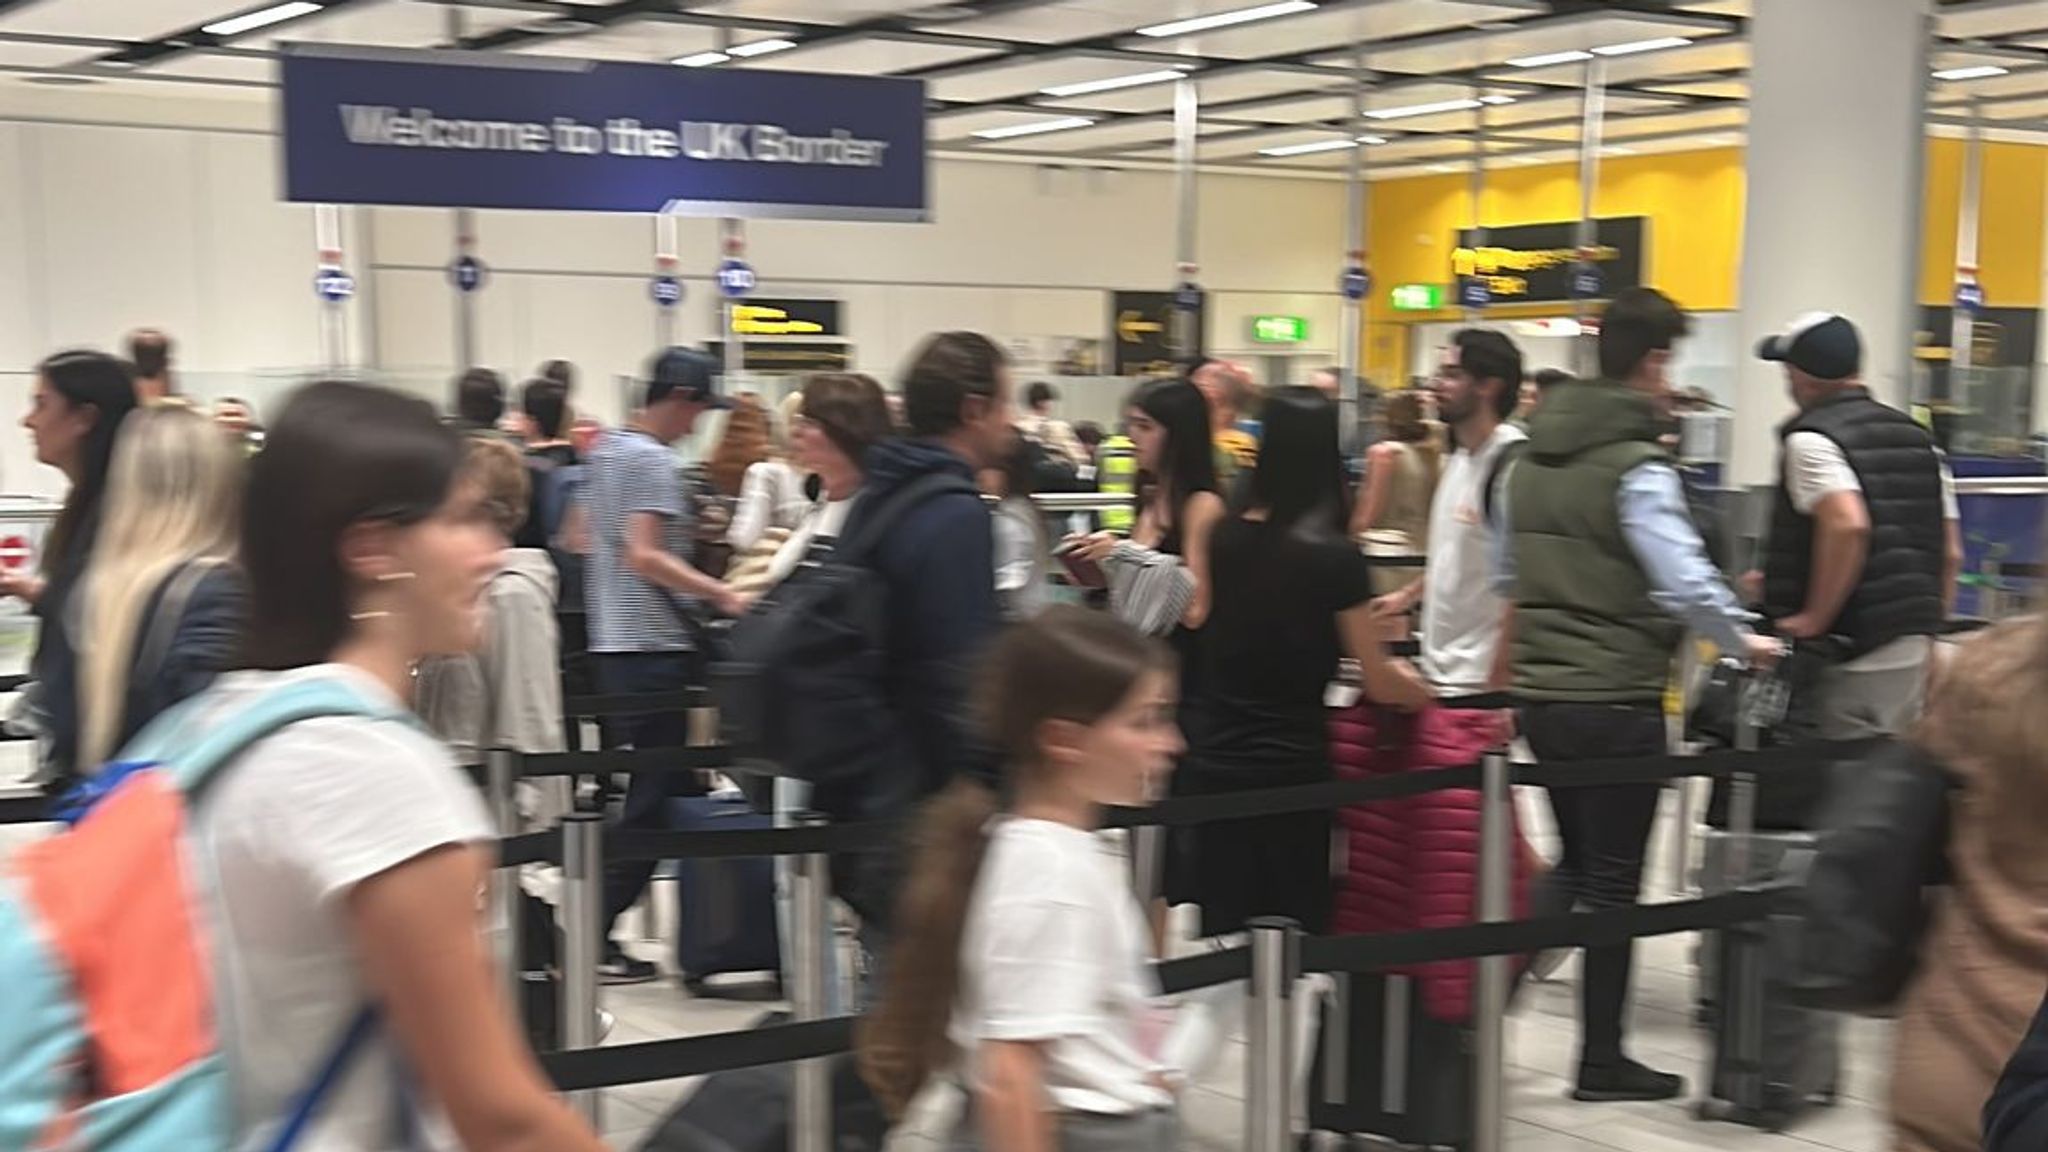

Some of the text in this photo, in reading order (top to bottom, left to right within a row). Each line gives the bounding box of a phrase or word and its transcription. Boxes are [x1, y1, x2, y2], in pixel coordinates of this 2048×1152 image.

[339, 103, 889, 168] Welcome to the UK Border
